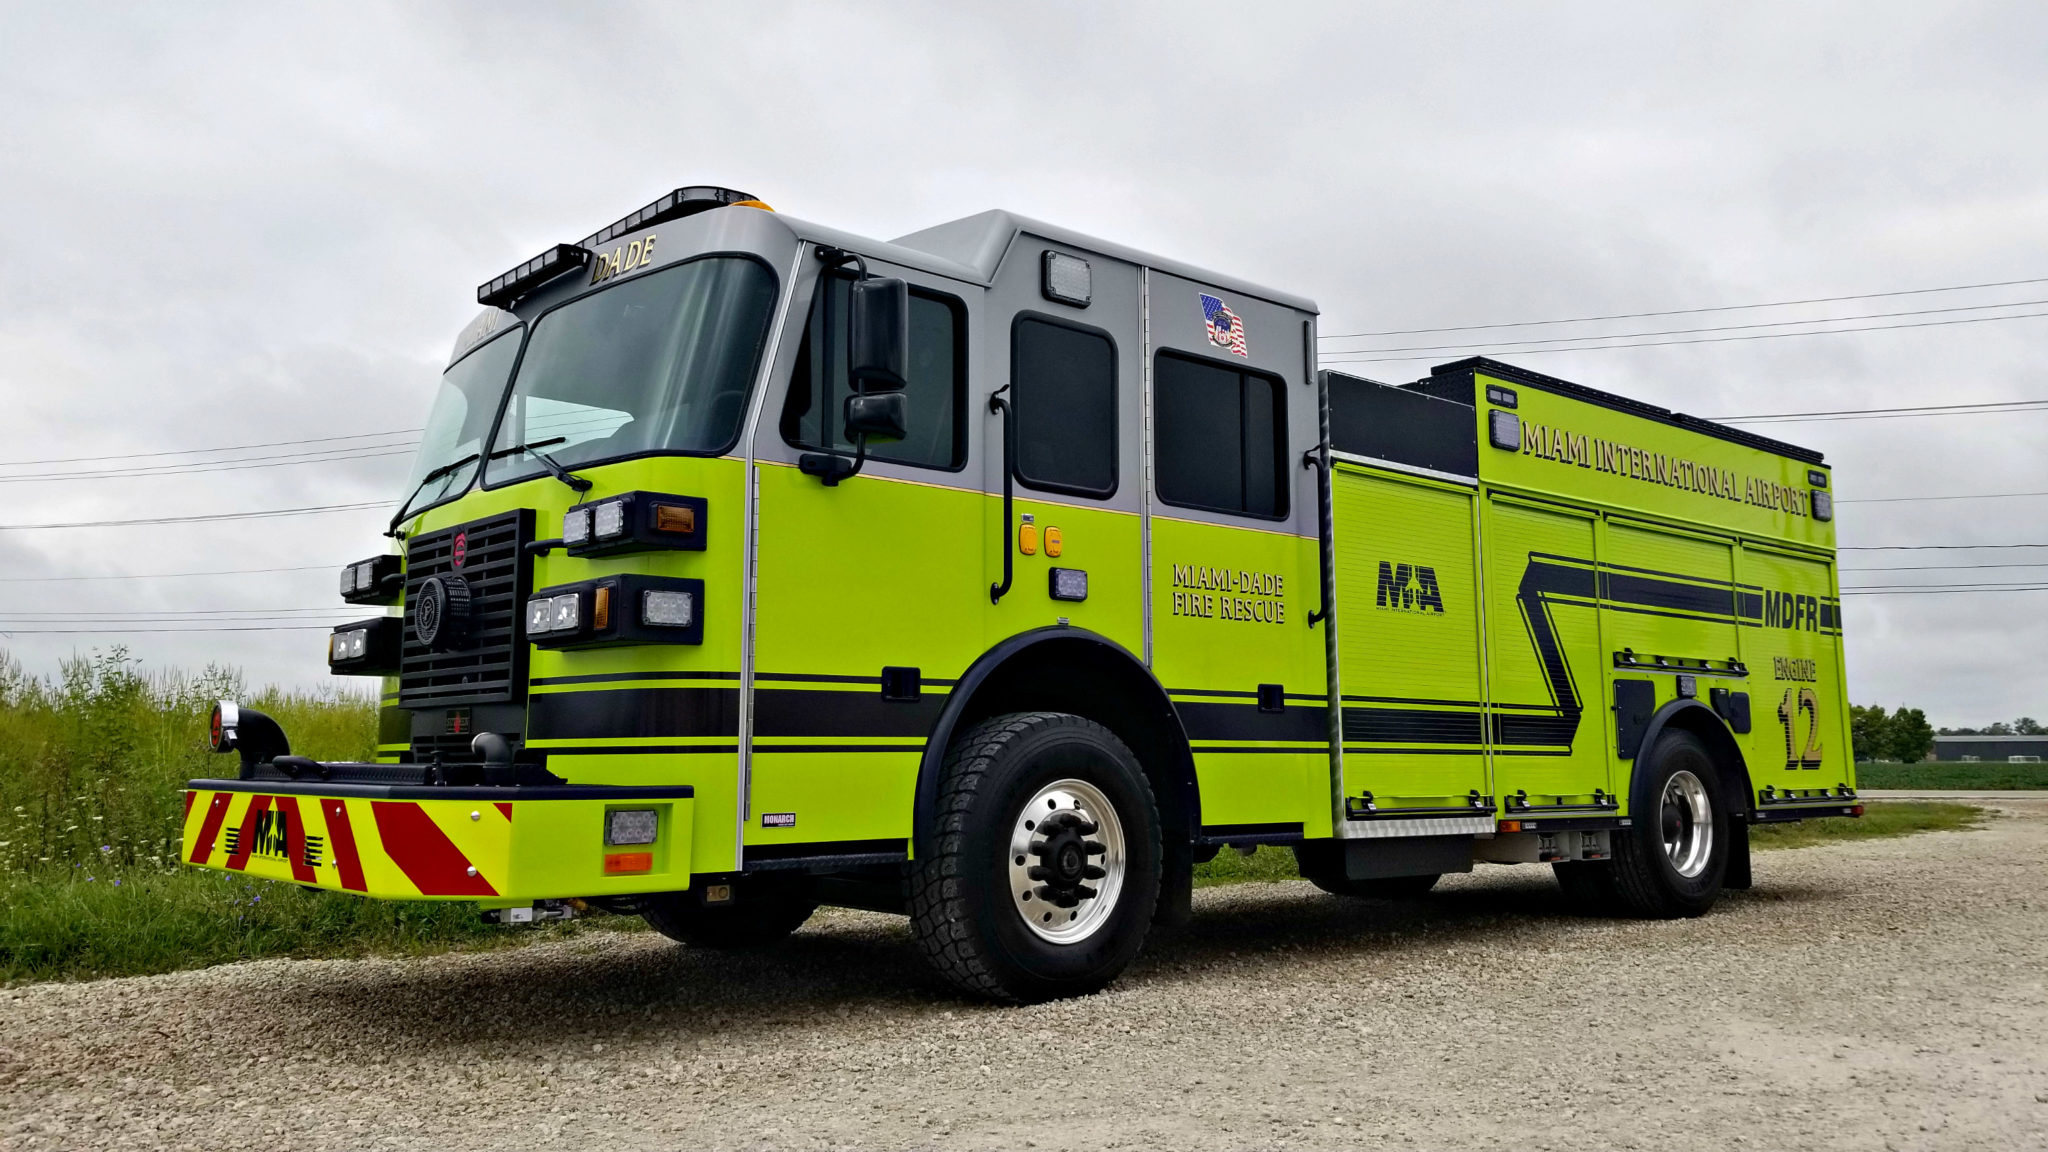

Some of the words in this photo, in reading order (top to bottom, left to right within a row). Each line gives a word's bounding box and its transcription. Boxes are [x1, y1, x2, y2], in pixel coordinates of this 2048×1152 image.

[589, 234, 656, 287] DADE
[1523, 421, 1591, 469] MIAMI
[1595, 438, 1742, 502] INTERNATIONAL
[1745, 475, 1808, 517] AIRPORT
[1173, 564, 1284, 597] MIAMI-DADE
[1173, 592, 1213, 618] FIRE
[1220, 596, 1285, 624] RESCUE
[1765, 590, 1818, 632] MDFR
[1773, 656, 1817, 682] ENGINE
[1777, 687, 1823, 770] 12
[764, 814, 794, 824] MONARCH
